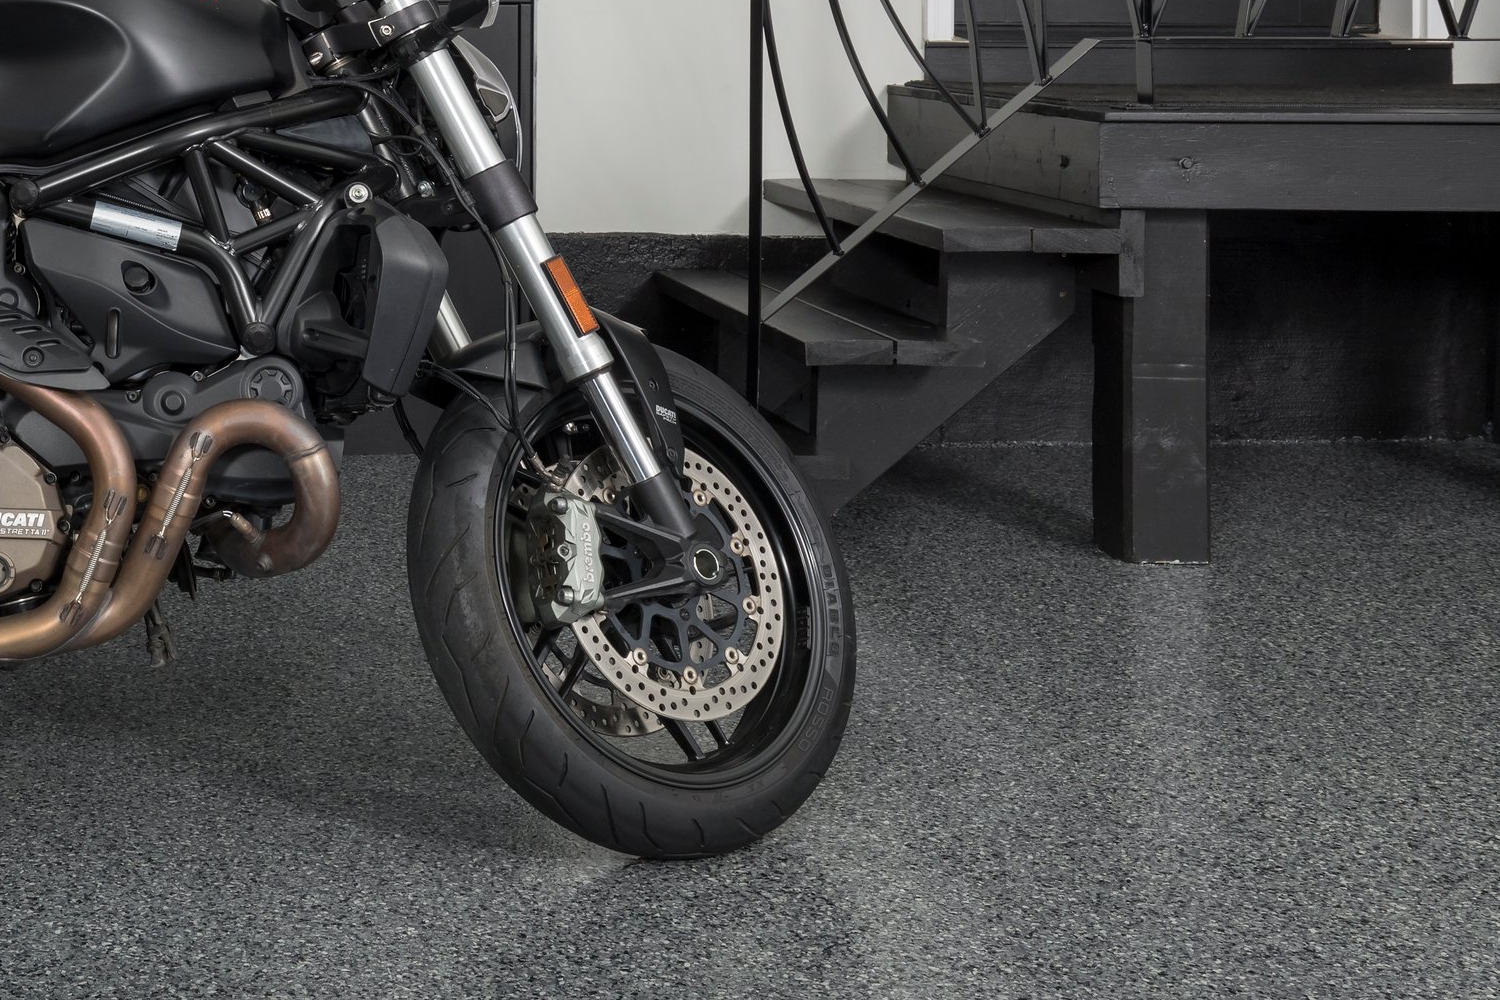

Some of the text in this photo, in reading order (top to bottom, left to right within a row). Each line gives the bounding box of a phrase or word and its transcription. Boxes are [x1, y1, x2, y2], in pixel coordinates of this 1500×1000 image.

[580, 522, 595, 583] brembo
[821, 564, 841, 657] DIABLO
[798, 686, 834, 752] ROSSO
